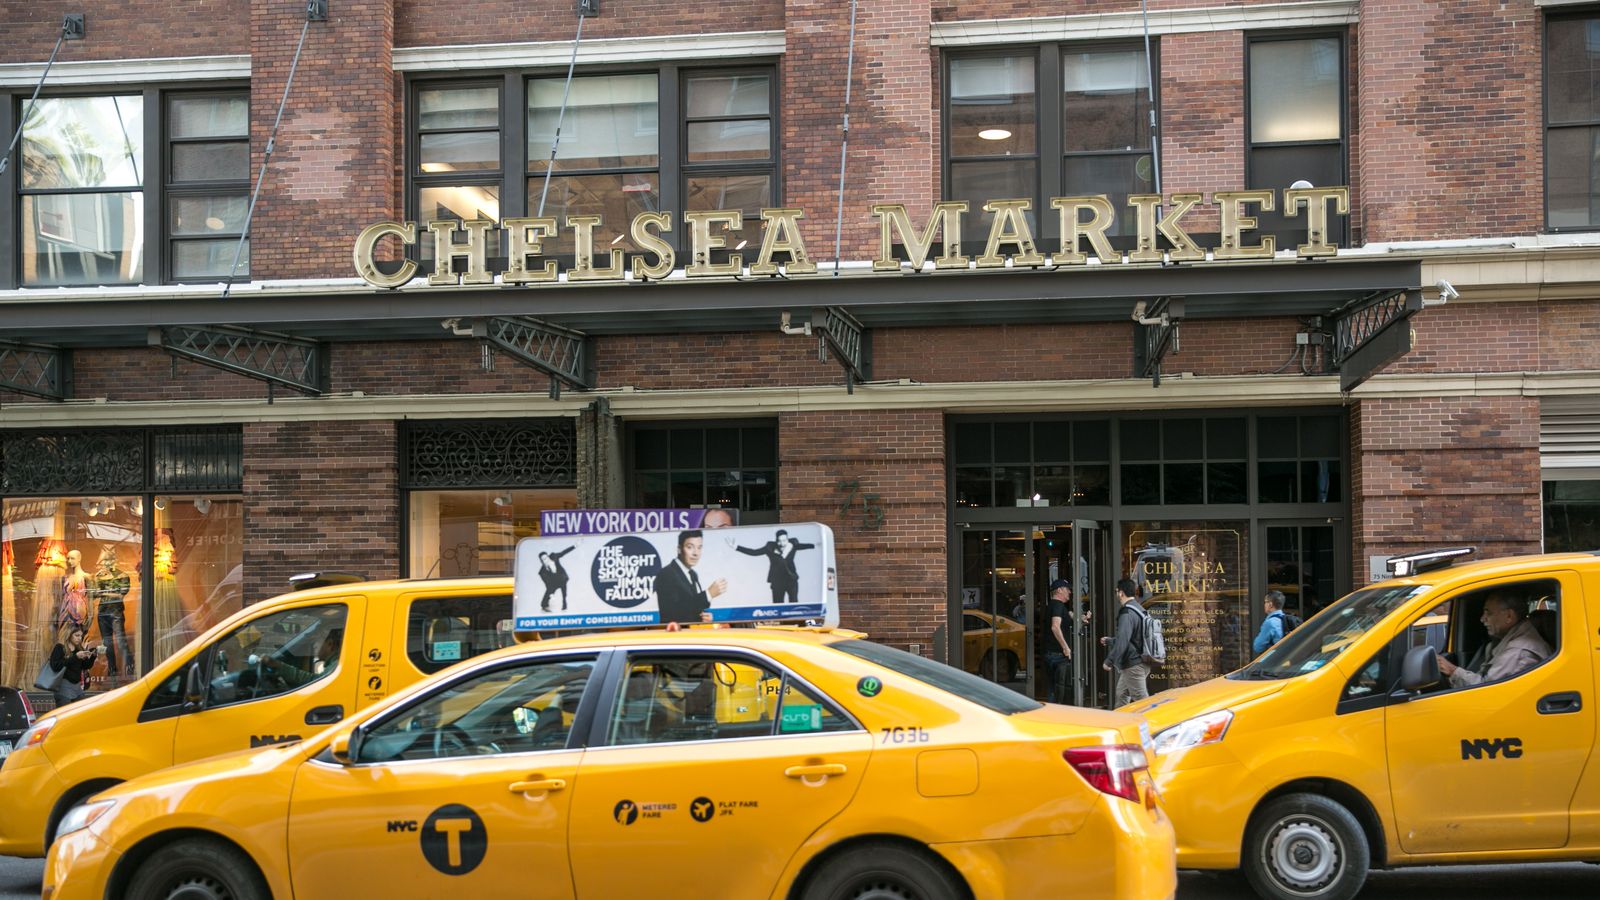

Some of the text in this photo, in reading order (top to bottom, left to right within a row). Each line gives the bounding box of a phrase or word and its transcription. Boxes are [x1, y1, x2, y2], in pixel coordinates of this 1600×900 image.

[353, 185, 1351, 289] CHELSEA MARKET
[837, 480, 884, 529] 75
[544, 511, 690, 533] NEW YORK DOLLS
[600, 545, 624, 558] THE
[598, 554, 657, 568] TONIGHT
[1144, 561, 1225, 575] CHELSEA
[598, 566, 640, 579] SHOW
[613, 575, 657, 589] JIMMY
[605, 587, 655, 601] FALLON
[519, 619, 537, 627] FOR
[538, 619, 559, 627] YOUR
[585, 614, 653, 625] CONSIDERATION
[1460, 737, 1523, 760] NYC
[642, 803, 678, 811] METERED
[387, 817, 473, 867] NYC T
